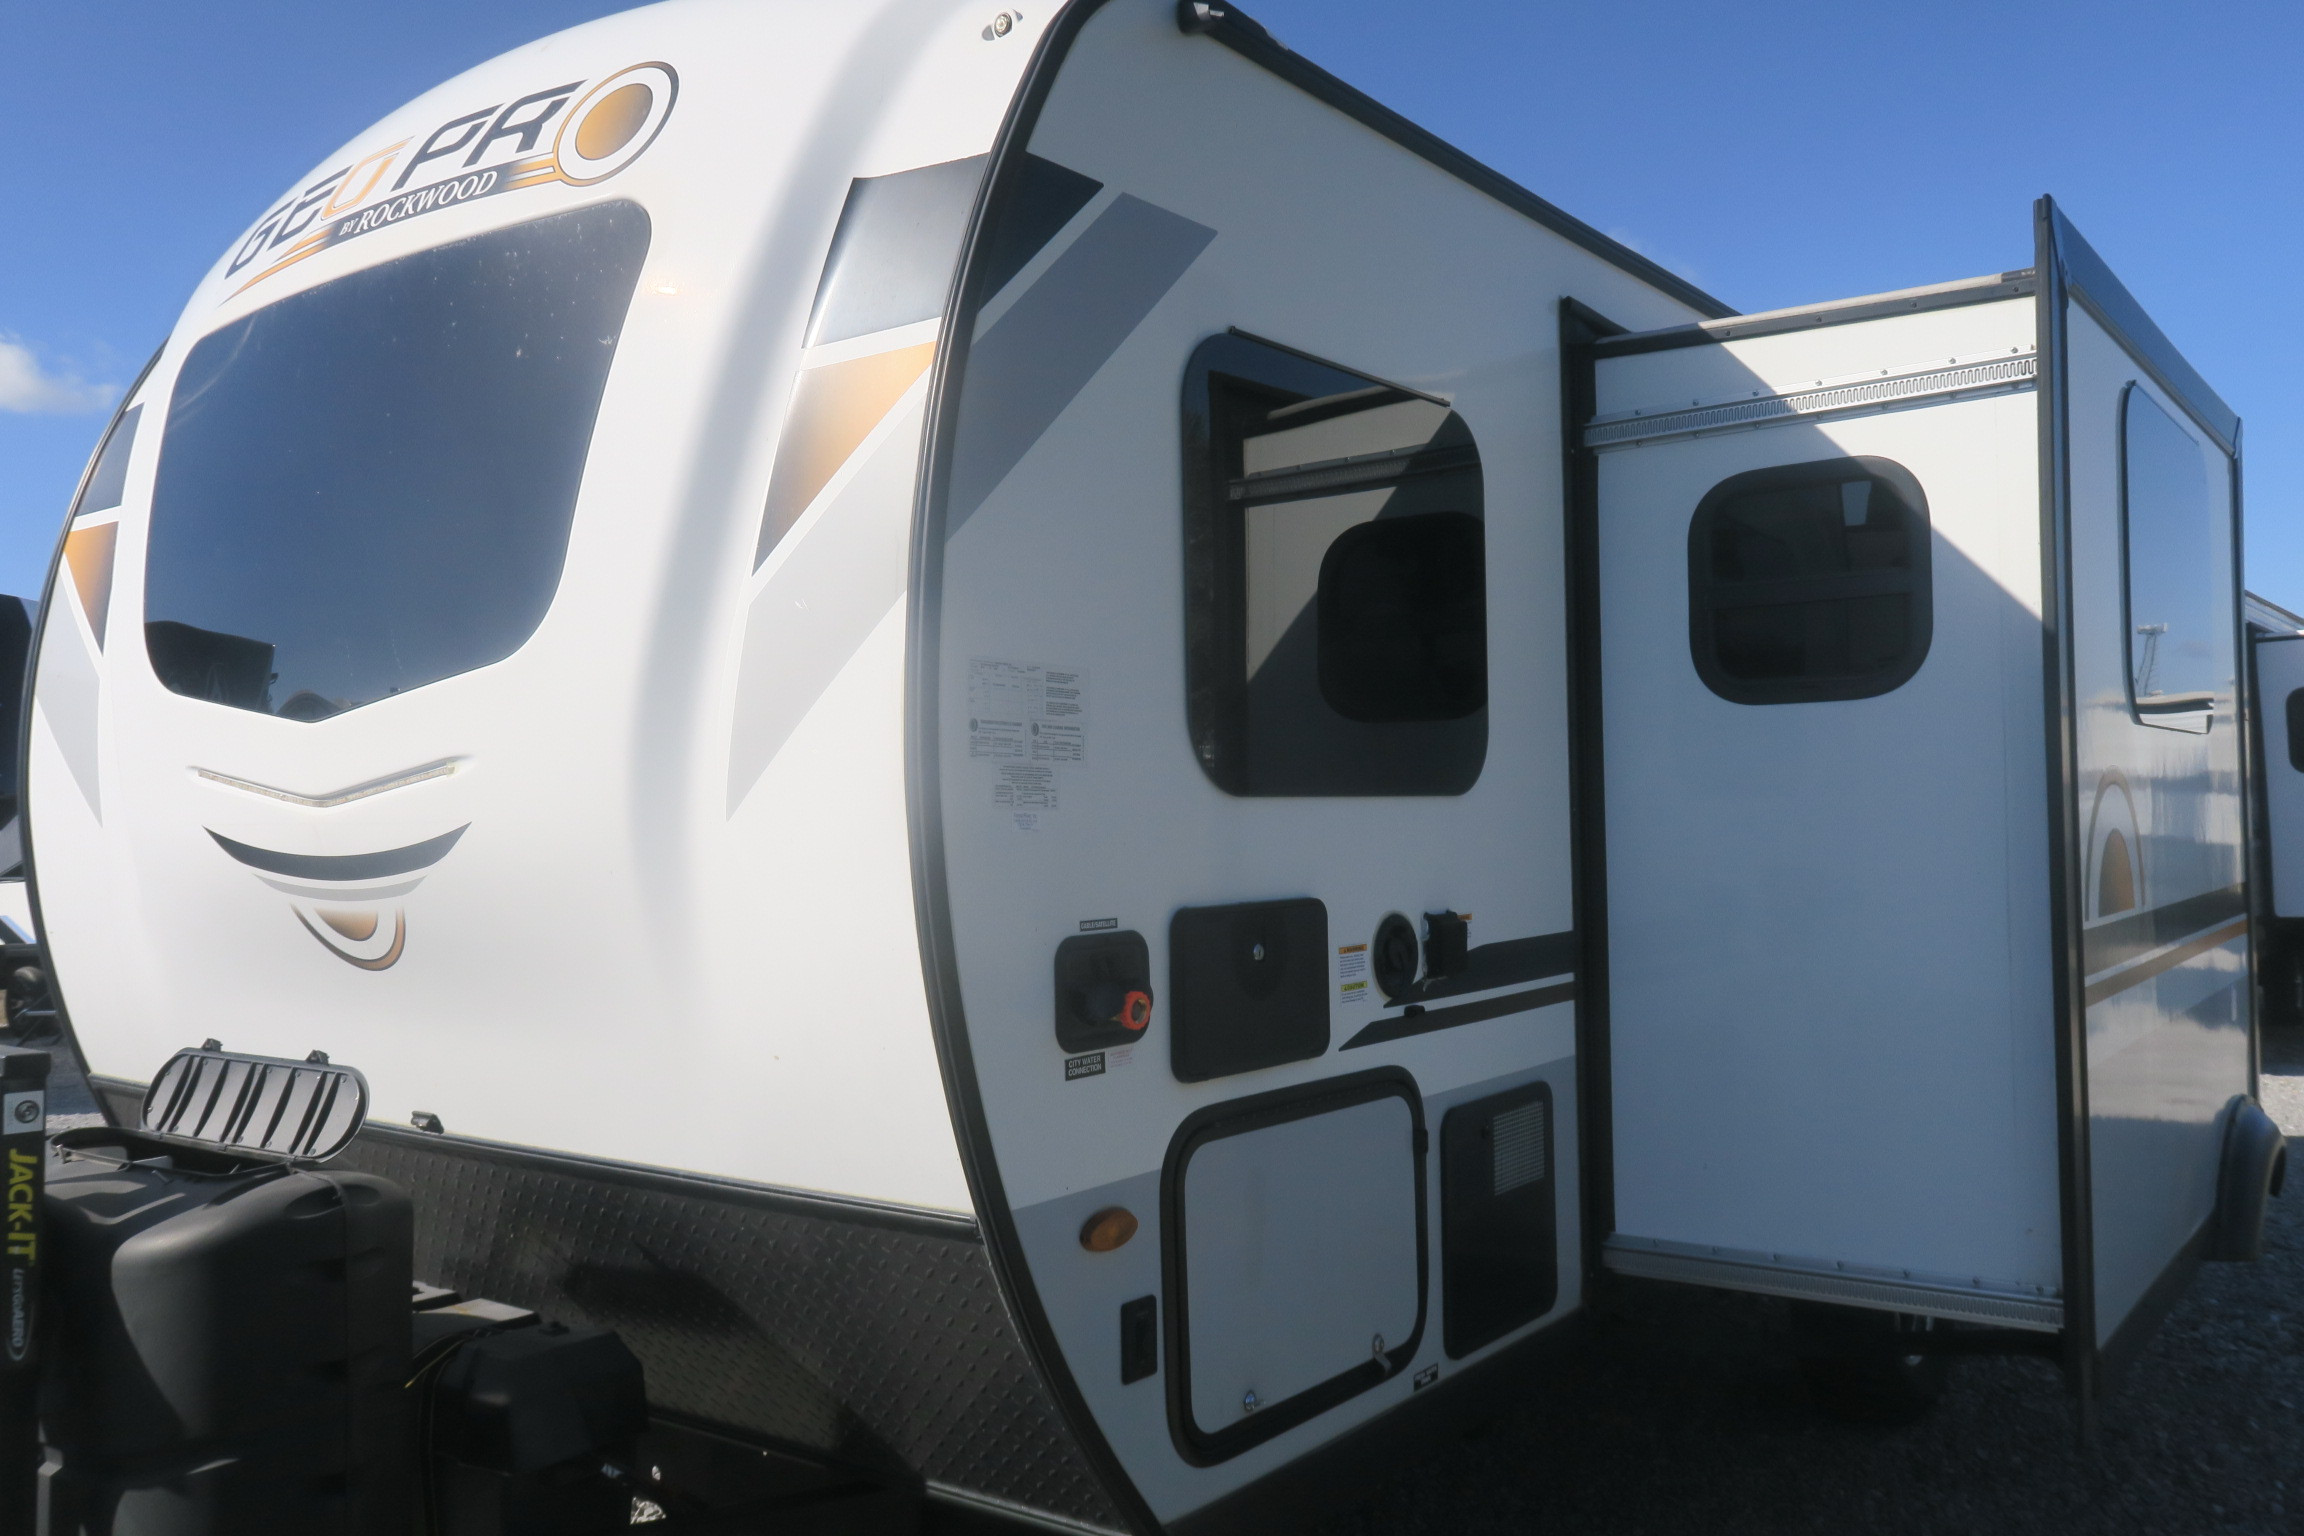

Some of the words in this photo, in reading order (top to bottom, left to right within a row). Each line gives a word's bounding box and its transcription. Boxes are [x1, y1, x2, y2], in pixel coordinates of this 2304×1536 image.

[225, 136, 415, 280] GEO
[390, 61, 680, 189] PRO
[339, 217, 358, 237] BY
[354, 171, 498, 234] ROCKWOOD
[1068, 1059, 1081, 1068] CITY
[1082, 1055, 1101, 1065] WATER
[1068, 1064, 1102, 1077] CONNECTION
[7, 1148, 38, 1262] JACK-IT
